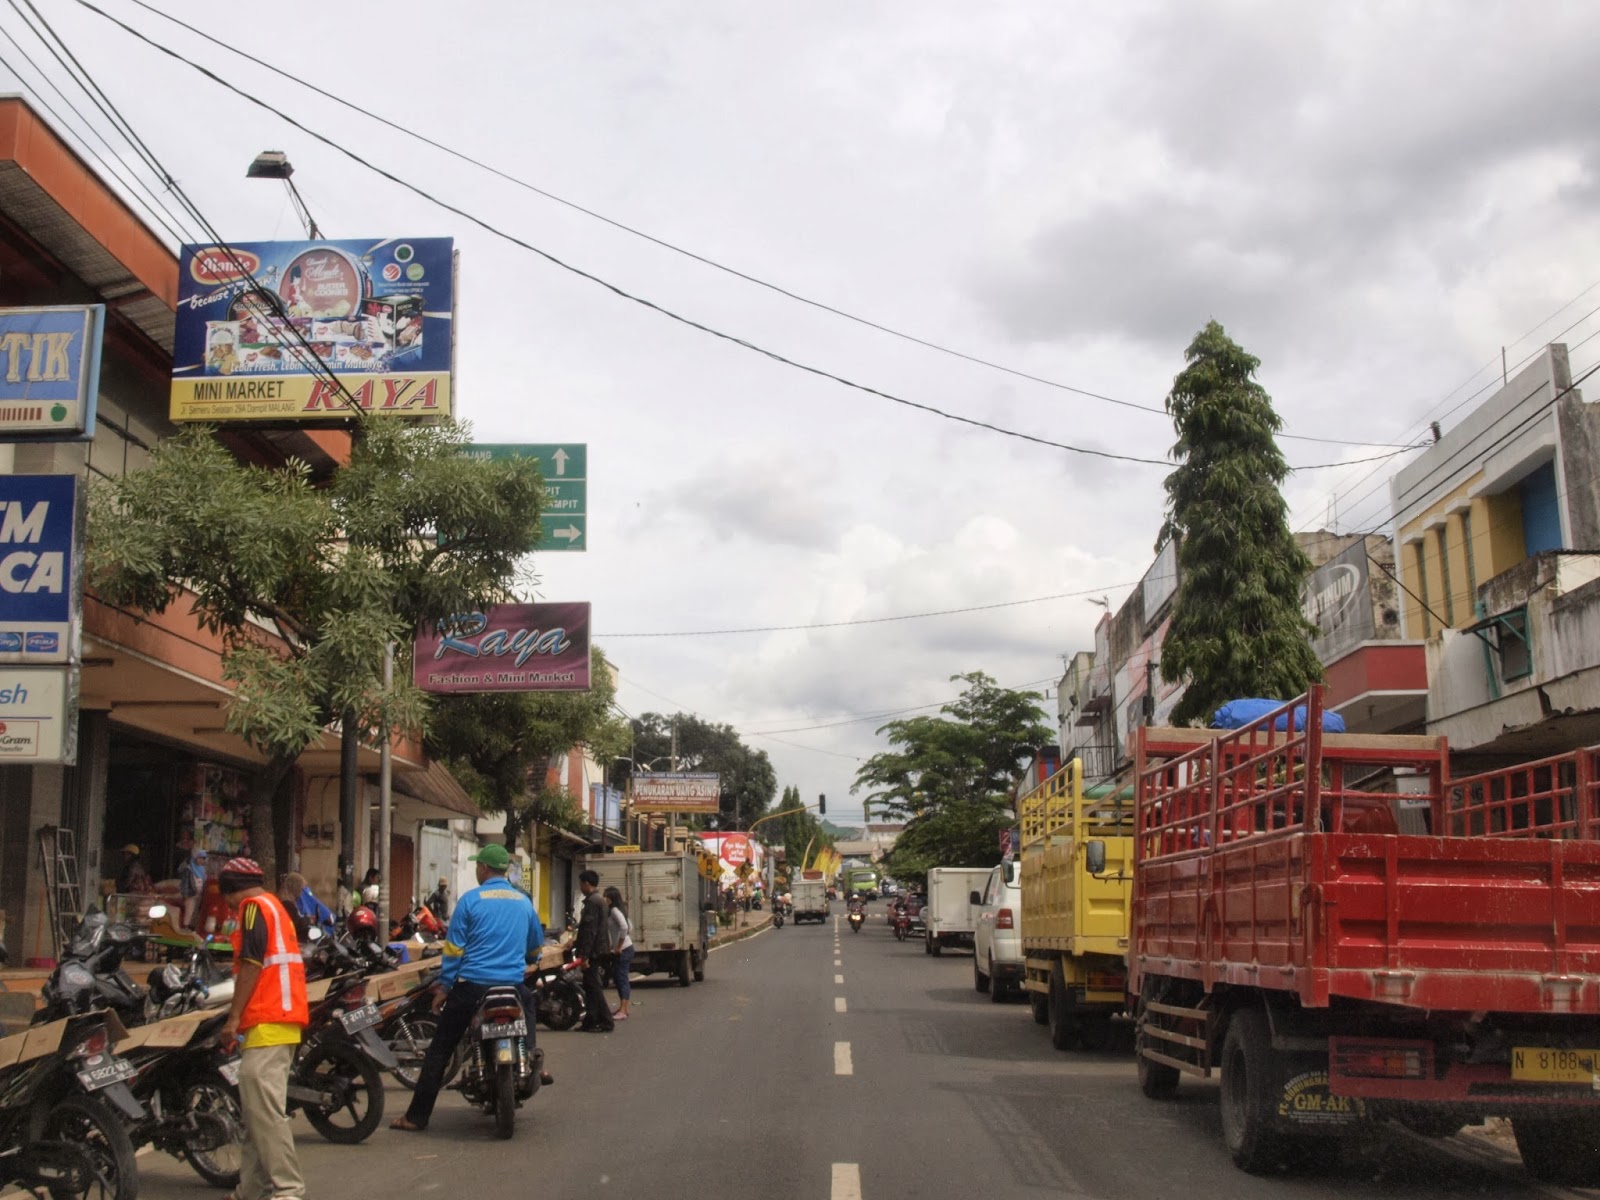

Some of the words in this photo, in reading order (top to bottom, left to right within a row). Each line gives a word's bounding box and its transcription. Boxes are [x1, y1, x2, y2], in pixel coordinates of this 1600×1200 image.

[190, 290, 229, 310] Because
[0, 332, 73, 383] TIK
[194, 382, 222, 400] MINI
[226, 381, 285, 399] MARKET
[302, 378, 438, 412] RAYA
[269, 403, 296, 412] MALANG
[434, 611, 571, 668] Raya
[429, 673, 479, 685] Fashion
[484, 673, 494, 684] &
[497, 671, 525, 683] Mini
[528, 671, 576, 683] Market
[635, 784, 675, 797] PENUKARAN
[676, 784, 697, 797] UANG
[697, 784, 719, 797] ASING
[1515, 1051, 1524, 1069] N
[1540, 1051, 1577, 1070] 8188
[1294, 1093, 1351, 1111] GM-AK
